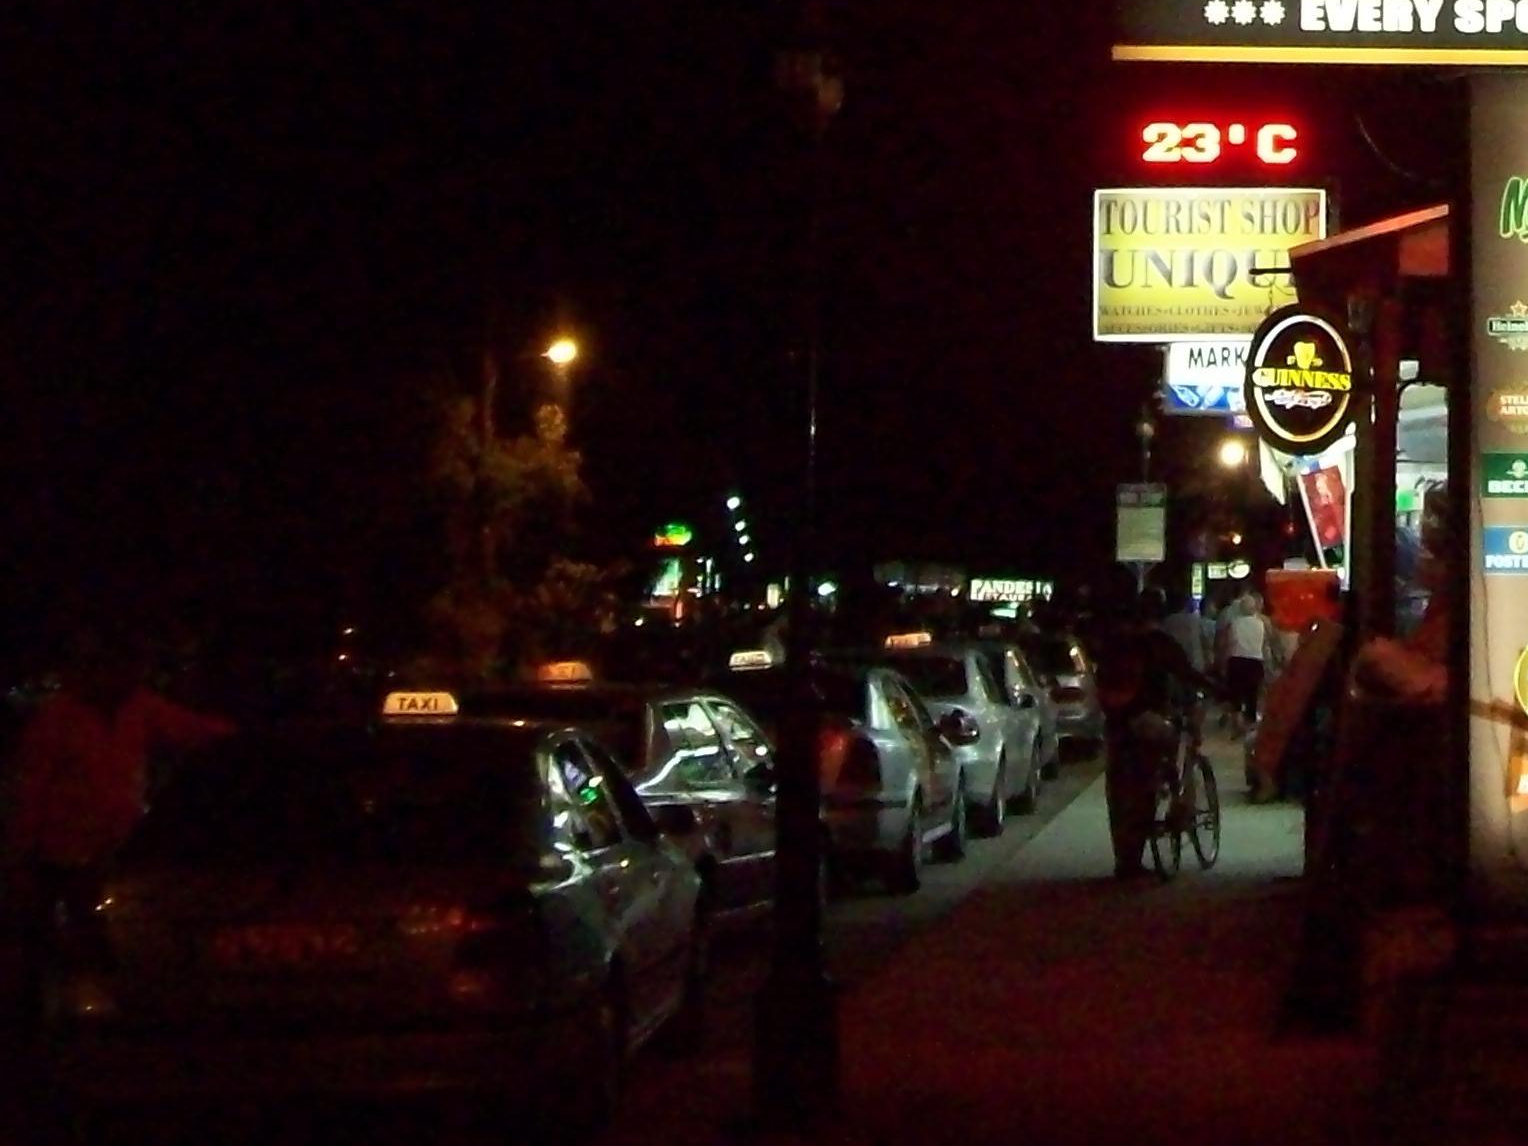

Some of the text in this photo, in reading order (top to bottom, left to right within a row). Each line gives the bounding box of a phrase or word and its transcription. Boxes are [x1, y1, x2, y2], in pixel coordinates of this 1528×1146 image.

[1100, 197, 1321, 236] TOURIST SHOP
[1101, 247, 1297, 300] UNIQU
[1252, 367, 1352, 392] GUINNESS
[398, 697, 439, 711] TAXI
